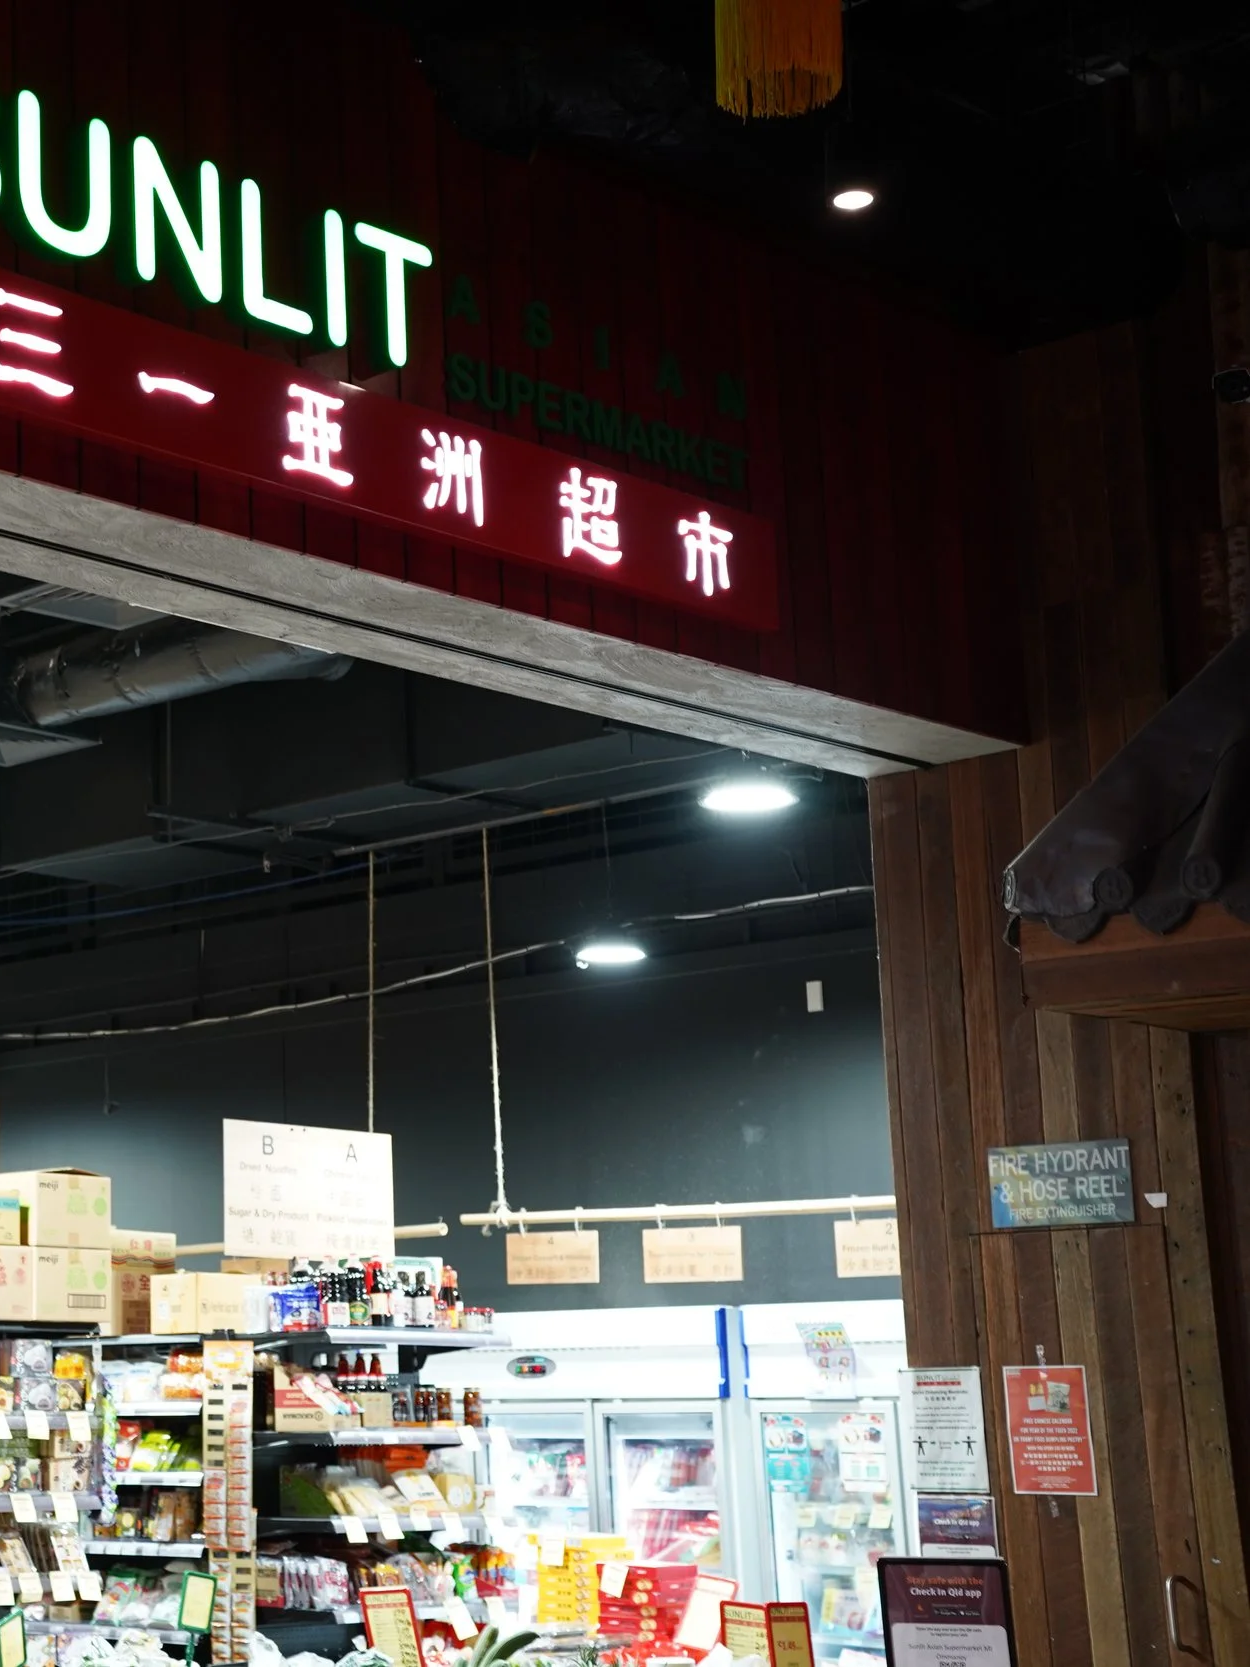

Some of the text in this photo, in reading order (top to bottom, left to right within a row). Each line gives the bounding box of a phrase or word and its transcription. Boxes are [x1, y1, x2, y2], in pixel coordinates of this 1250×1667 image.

[449, 274, 748, 421] ASIAN
[447, 353, 749, 491] SUPERMARKET
[262, 1134, 275, 1156] B
[345, 1143, 358, 1163] A
[988, 1145, 1130, 1177] FIRE HYDRANT
[38, 1180, 59, 1192] meiji
[1000, 1174, 1126, 1204] & HOSE REEL
[228, 1206, 252, 1219] Sugar
[254, 1208, 261, 1218] &
[262, 1208, 276, 1220] Dry
[1009, 1203, 1116, 1221] FIRE EXTINGUISHER
[885, 1222, 894, 1235] 2
[38, 1254, 59, 1265] meiji
[948, 1576, 966, 1586] with
[968, 1577, 984, 1586] the
[909, 1586, 937, 1597] Check
[948, 1588, 964, 1598] Qld
[965, 1590, 982, 1599] app
